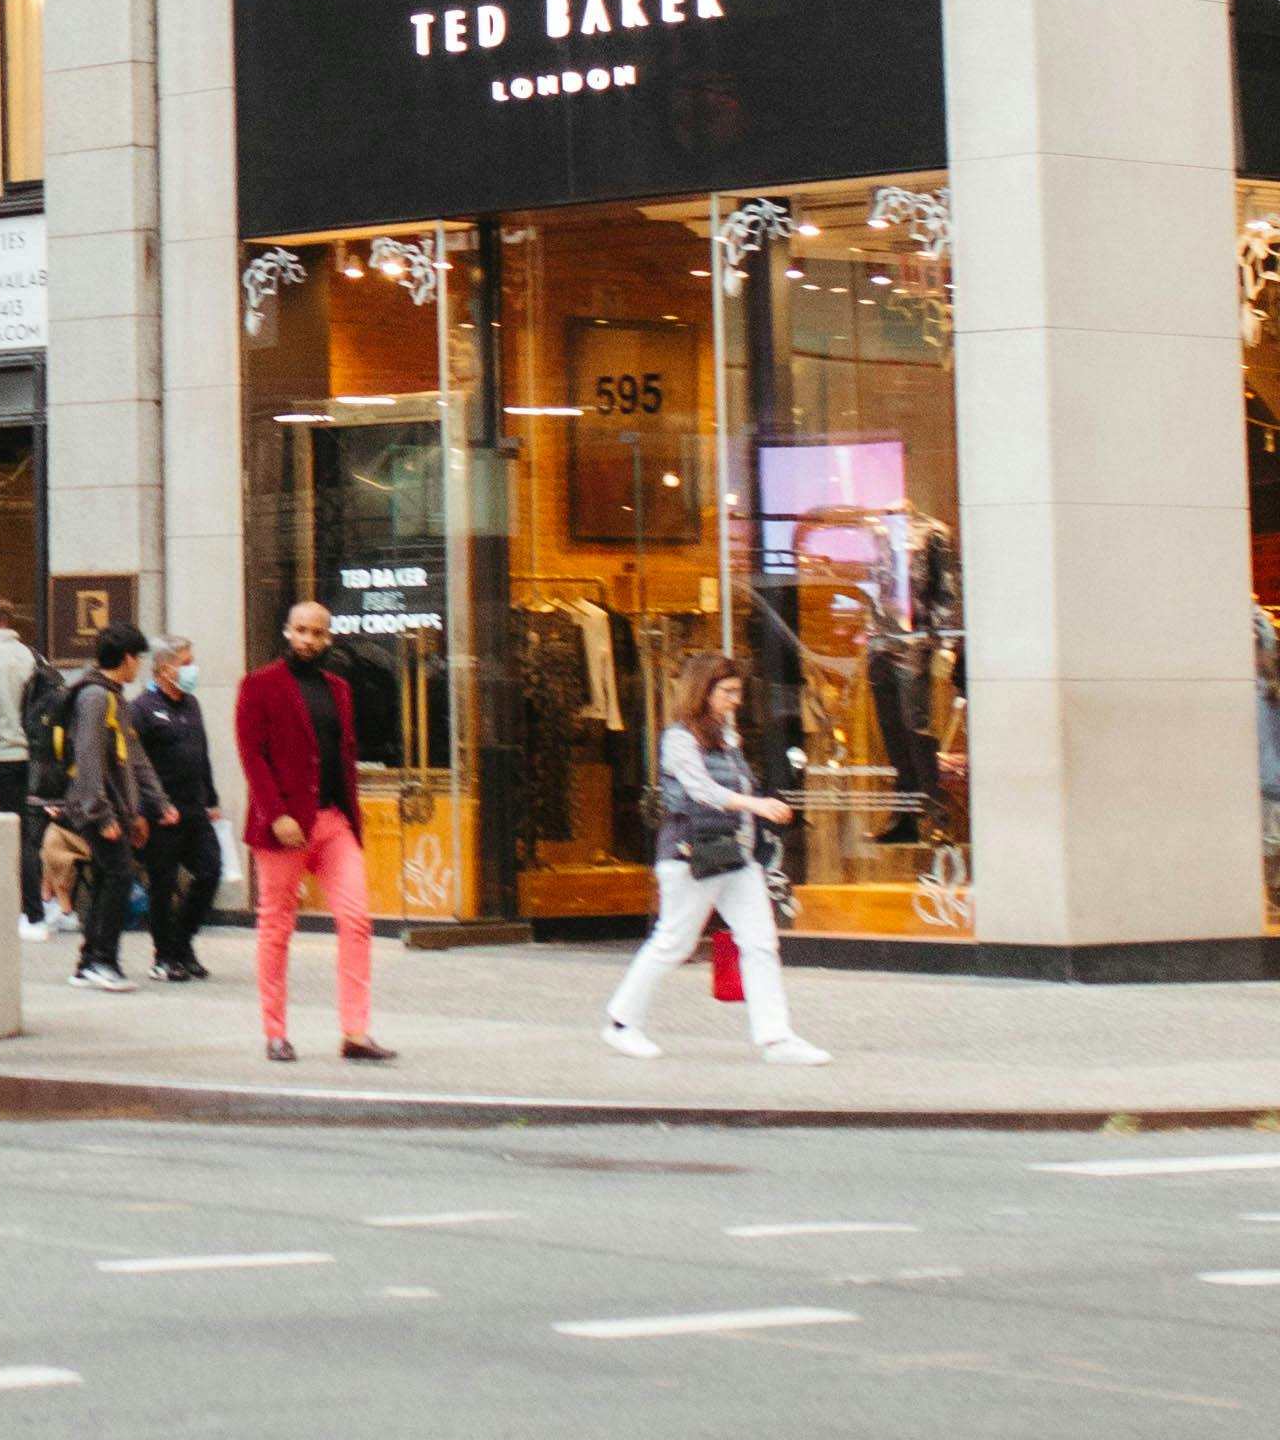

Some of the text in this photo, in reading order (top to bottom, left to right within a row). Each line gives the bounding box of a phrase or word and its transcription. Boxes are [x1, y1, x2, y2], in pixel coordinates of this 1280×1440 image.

[410, 5, 506, 56] TED
[492, 65, 637, 102] LONDON
[594, 373, 664, 415] 595
